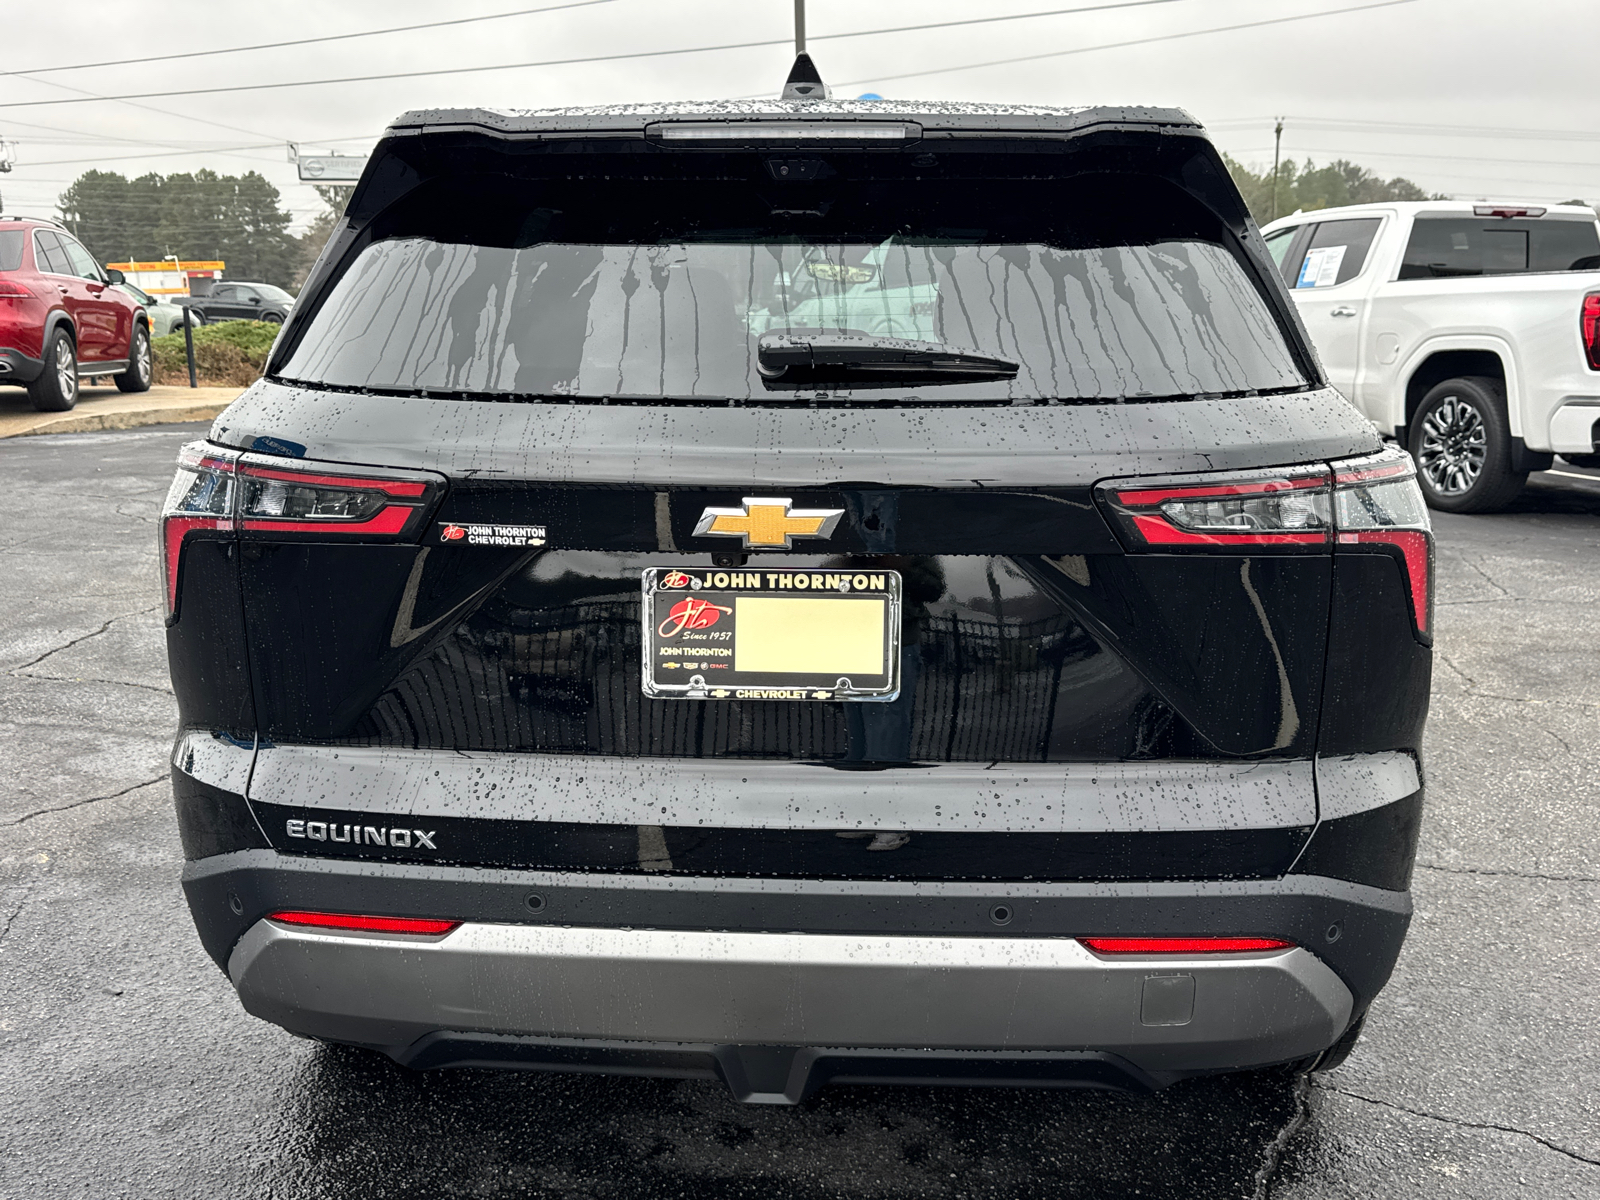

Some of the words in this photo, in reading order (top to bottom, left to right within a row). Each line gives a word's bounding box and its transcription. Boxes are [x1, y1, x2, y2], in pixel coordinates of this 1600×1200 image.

[468, 525, 493, 536] JOHN
[493, 527, 546, 537] THORNTON
[468, 535, 527, 545] CHEVROLET
[703, 572, 761, 589] JOHN
[682, 630, 707, 640] Since
[709, 631, 733, 641] 1957
[659, 647, 683, 656] JOHN
[683, 647, 732, 657] THORNTON
[735, 689, 808, 699] CHEVROLET
[286, 819, 437, 850] EQUINOX
